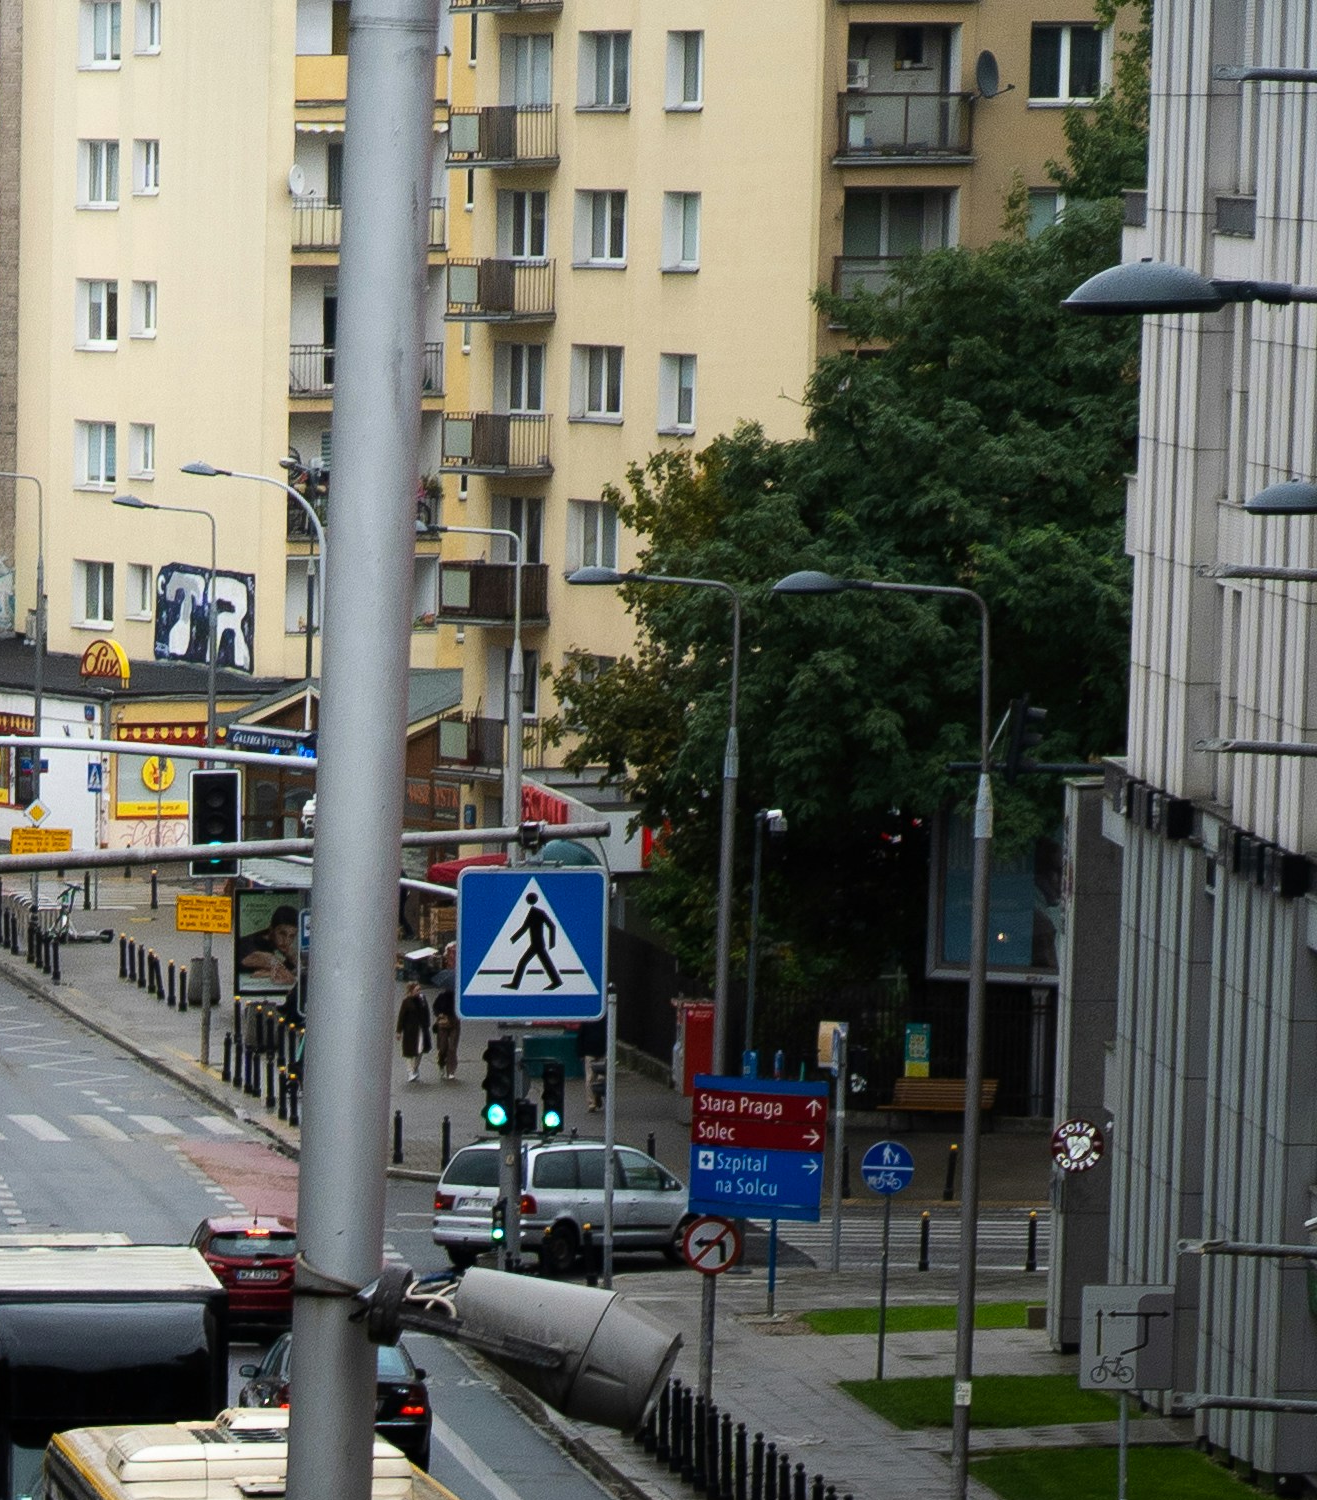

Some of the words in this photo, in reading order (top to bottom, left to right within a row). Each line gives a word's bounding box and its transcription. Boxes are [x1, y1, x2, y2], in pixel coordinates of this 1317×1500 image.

[699, 1092, 736, 1114] Stara
[739, 1097, 783, 1120] Praga
[698, 1121, 736, 1142] Solec
[1058, 1122, 1096, 1138] COSTA
[716, 1152, 768, 1174] Szpital
[1056, 1151, 1101, 1171] COFFEE
[715, 1179, 733, 1195] na
[735, 1178, 778, 1197] Solcu
